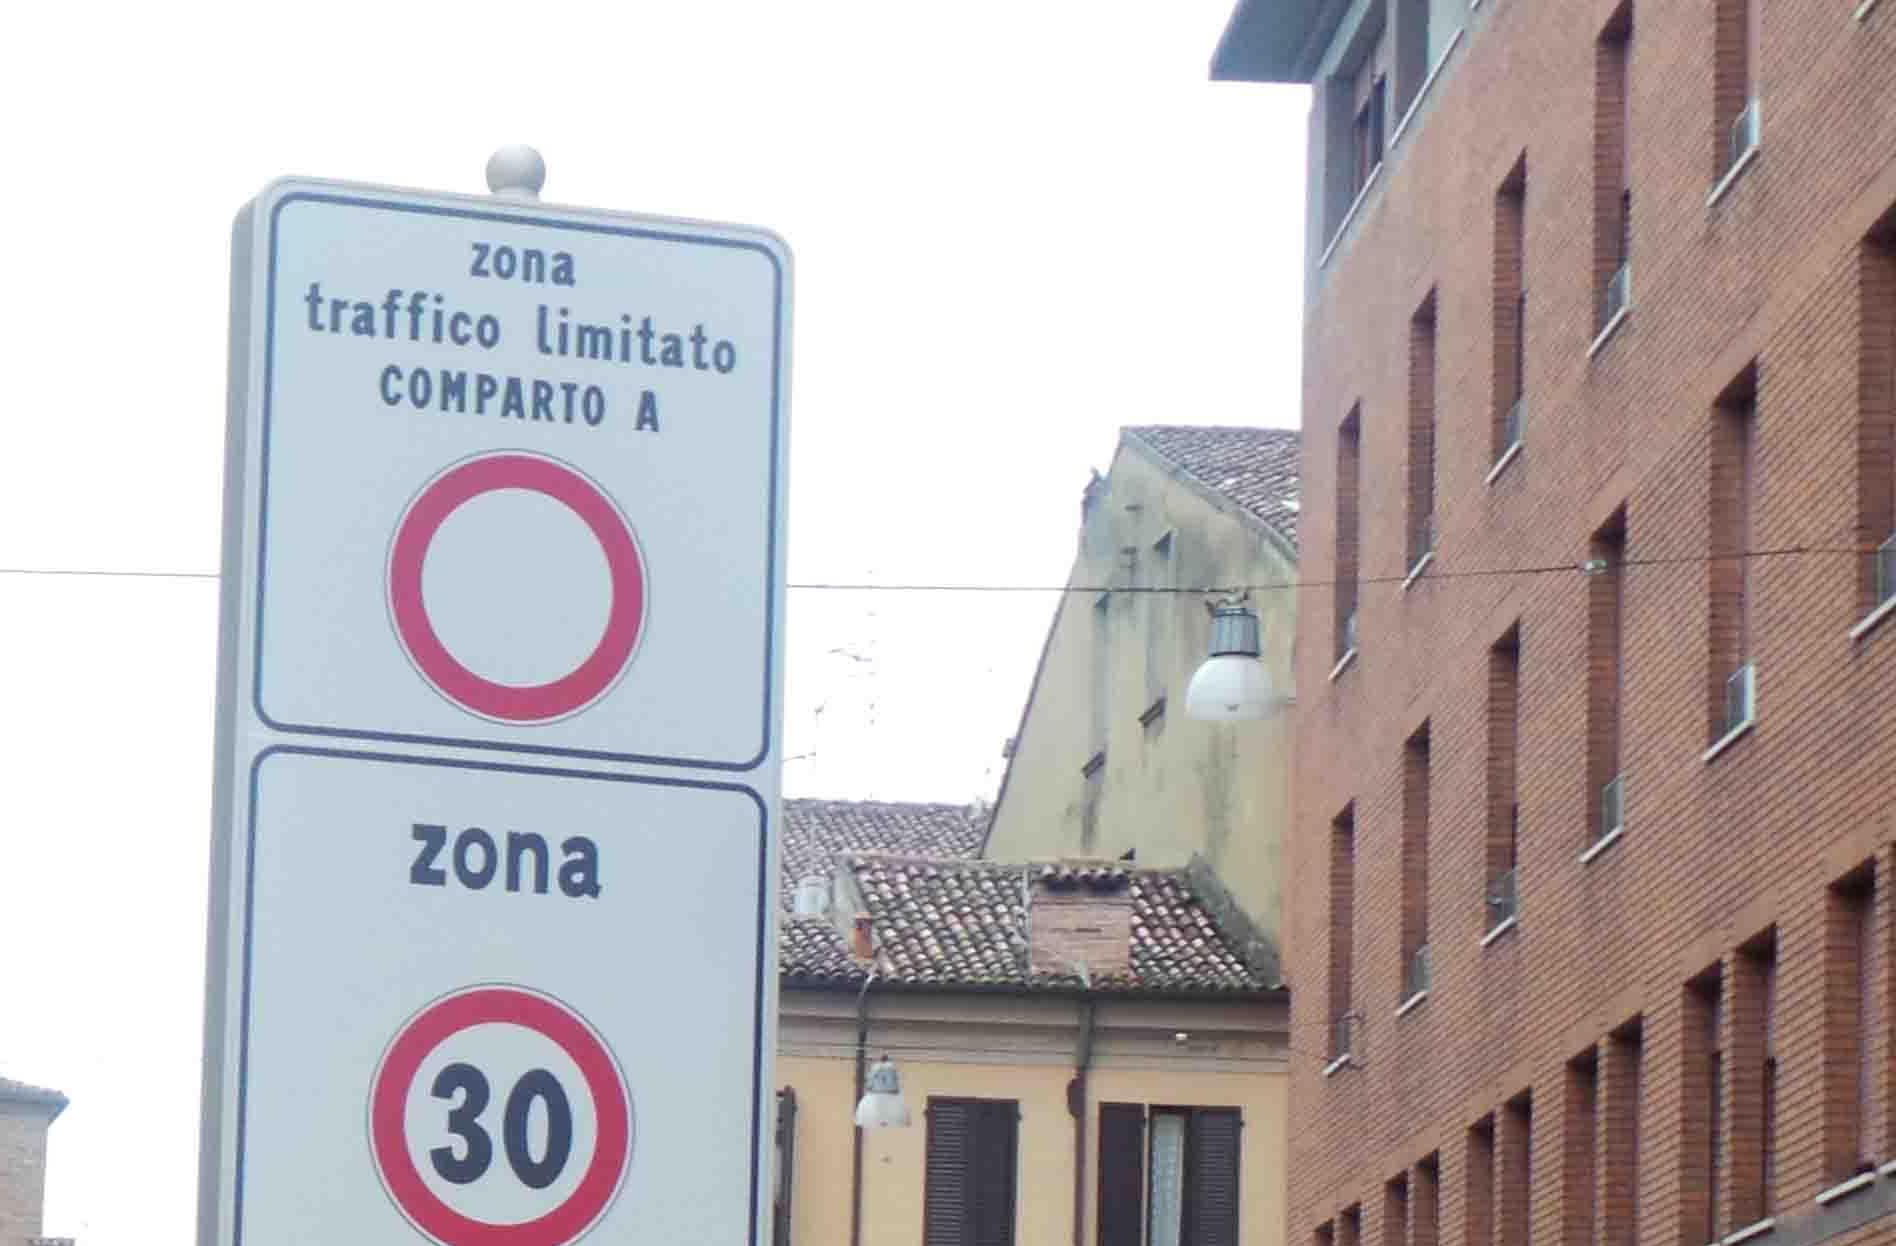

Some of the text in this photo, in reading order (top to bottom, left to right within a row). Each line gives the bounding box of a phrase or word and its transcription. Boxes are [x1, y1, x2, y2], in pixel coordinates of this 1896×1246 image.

[470, 242, 577, 287] zona
[304, 282, 736, 374] traffico limitato
[380, 364, 660, 433] COMPARTO A
[410, 823, 602, 899] zona
[429, 1062, 573, 1190] 30
